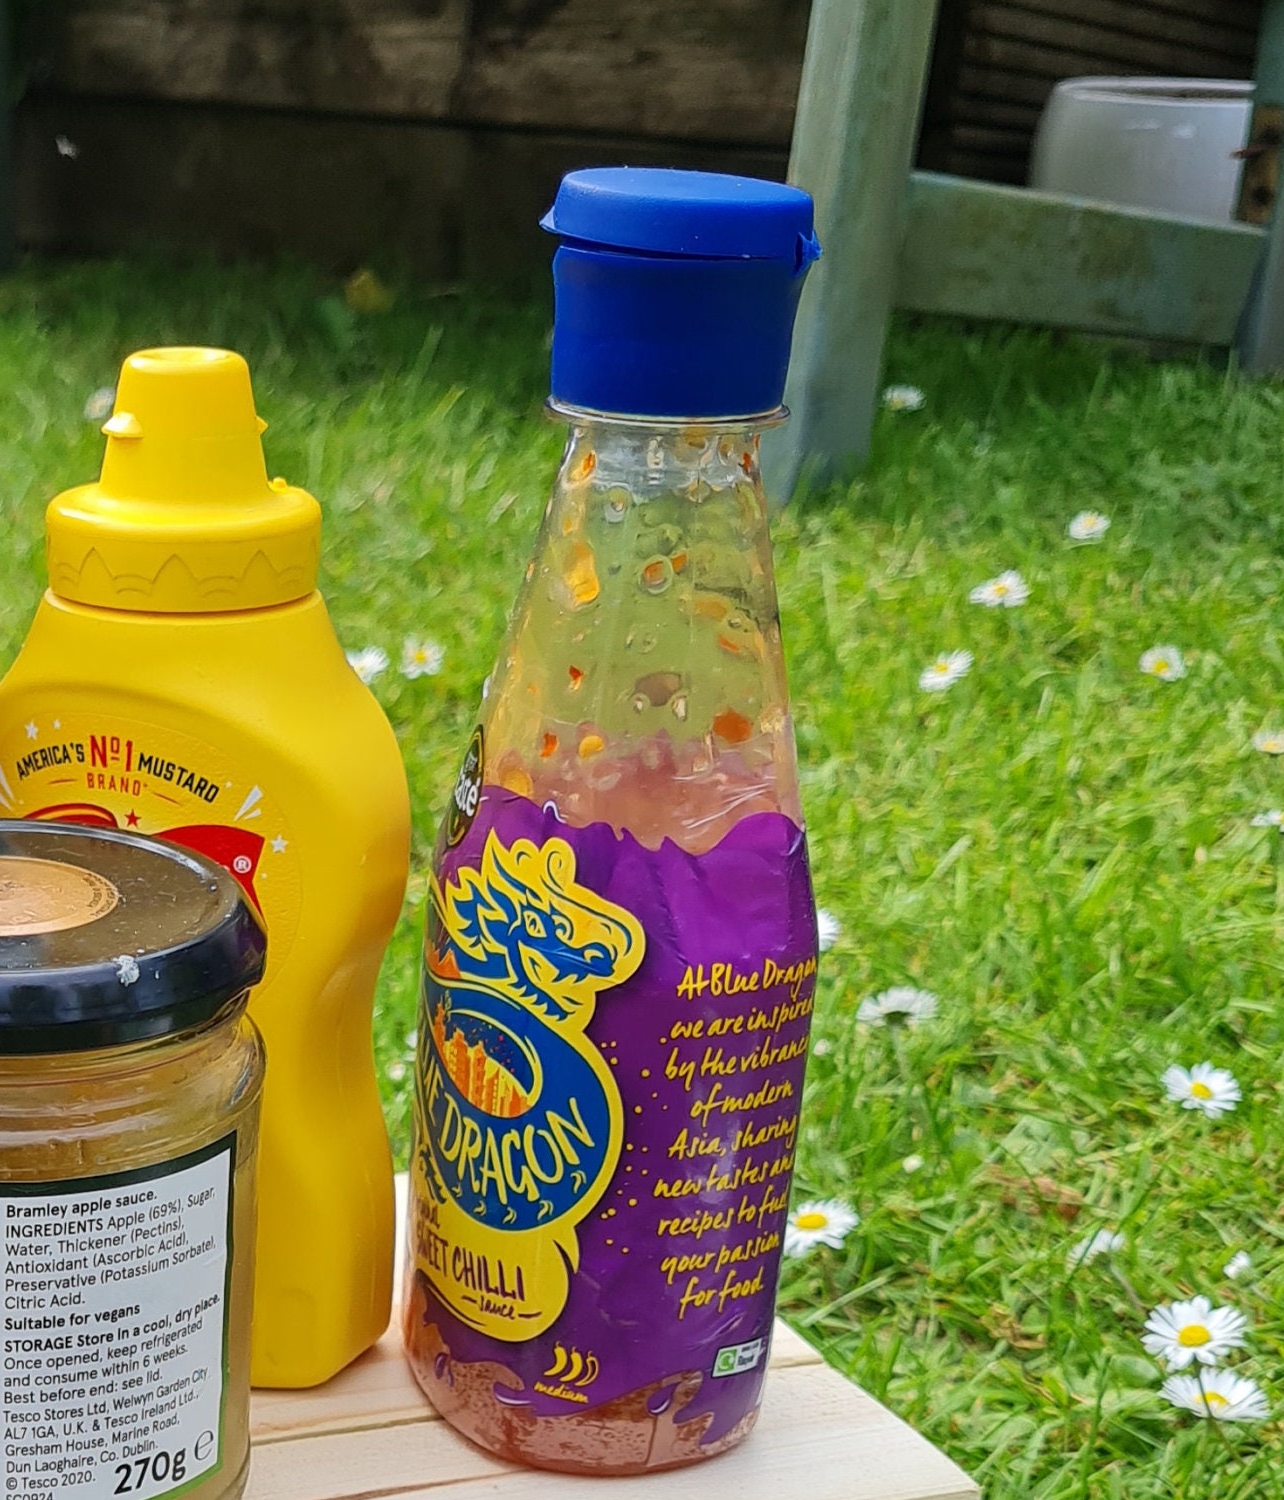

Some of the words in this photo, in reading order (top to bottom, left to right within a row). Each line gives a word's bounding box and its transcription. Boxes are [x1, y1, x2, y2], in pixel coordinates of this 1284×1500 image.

[16, 742, 85, 781] AMERICA'S
[137, 752, 221, 804] MUSTARD
[86, 772, 141, 797] BRAND
[677, 963, 709, 1000] At
[711, 962, 759, 996] Blue
[670, 1019, 703, 1039] we
[707, 1015, 743, 1037] are
[665, 1047, 696, 1091] by
[701, 1047, 736, 1077] the
[690, 1082, 723, 1127] of
[721, 1079, 793, 1113] modern
[438, 1096, 595, 1205] DRAGON
[668, 1128, 726, 1160] Asia,
[731, 1114, 797, 1151] sharing
[654, 1178, 702, 1198] new
[706, 1156, 769, 1193] tastes
[7, 1203, 67, 1218] Bramley
[72, 1197, 111, 1214] apple
[116, 1189, 157, 1208] sauce.
[657, 1206, 734, 1239] recipes
[737, 1195, 757, 1224] to
[6, 1218, 104, 1238] INGREDIENTS
[107, 1211, 145, 1231] Apple
[4, 1255, 88, 1274] Antioxidant
[93, 1242, 155, 1267] (Ascorbic
[5, 1242, 53, 1257] Water,
[57, 1234, 127, 1254] Thickener
[661, 1252, 715, 1285] your
[715, 1231, 780, 1274] passion
[5, 1273, 96, 1292] Preservative
[100, 1256, 170, 1285] (Potassium
[452, 1245, 525, 1302] CHILLI
[5, 1295, 45, 1310] Citric
[50, 1291, 86, 1307] Acid.
[5, 1312, 65, 1331] Suitable
[70, 1310, 91, 1325] for
[94, 1303, 140, 1322] vegans
[679, 1276, 716, 1320] for
[5, 1334, 73, 1353] STORAGE
[77, 1329, 114, 1347] Store
[118, 1325, 129, 1341] in
[143, 1312, 172, 1335] cool,
[175, 1307, 193, 1325] dry
[5, 1356, 42, 1371] Once
[46, 1350, 103, 1371] opened,
[107, 1343, 137, 1361] keep
[141, 1319, 203, 1352] refrigerated
[5, 1373, 30, 1388] and
[34, 1369, 98, 1386] consume
[102, 1357, 140, 1377] within
[153, 1343, 189, 1365] weeks.
[4, 1410, 41, 1424] Tesco
[44, 1403, 84, 1421] Stores
[87, 1401, 110, 1418] Ltd,
[113, 1391, 154, 1411] Welwyn
[156, 1376, 190, 1399] Garden
[5, 1391, 35, 1405] Best
[39, 1385, 86, 1403] before
[90, 1380, 118, 1399] end:
[122, 1376, 143, 1391] see
[147, 1369, 163, 1384] lid.
[534, 1381, 589, 1404] medium
[4, 1427, 27, 1440] AL7
[31, 1425, 59, 1440] 1GA,
[63, 1421, 88, 1436] U.K.
[104, 1413, 139, 1429] Tesco
[141, 1399, 177, 1421] Ireland
[5, 1440, 62, 1457] Gresham
[66, 1434, 108, 1452] House,
[112, 1425, 150, 1445] Marine
[7, 1460, 31, 1473] Dun
[35, 1454, 97, 1472] Laoghaire,
[100, 1448, 120, 1463] Co.
[122, 1439, 159, 1458] Dublin.
[21, 1477, 58, 1490] Tesco
[62, 1470, 96, 1487] 2020.
[114, 1448, 187, 1495] 270g
